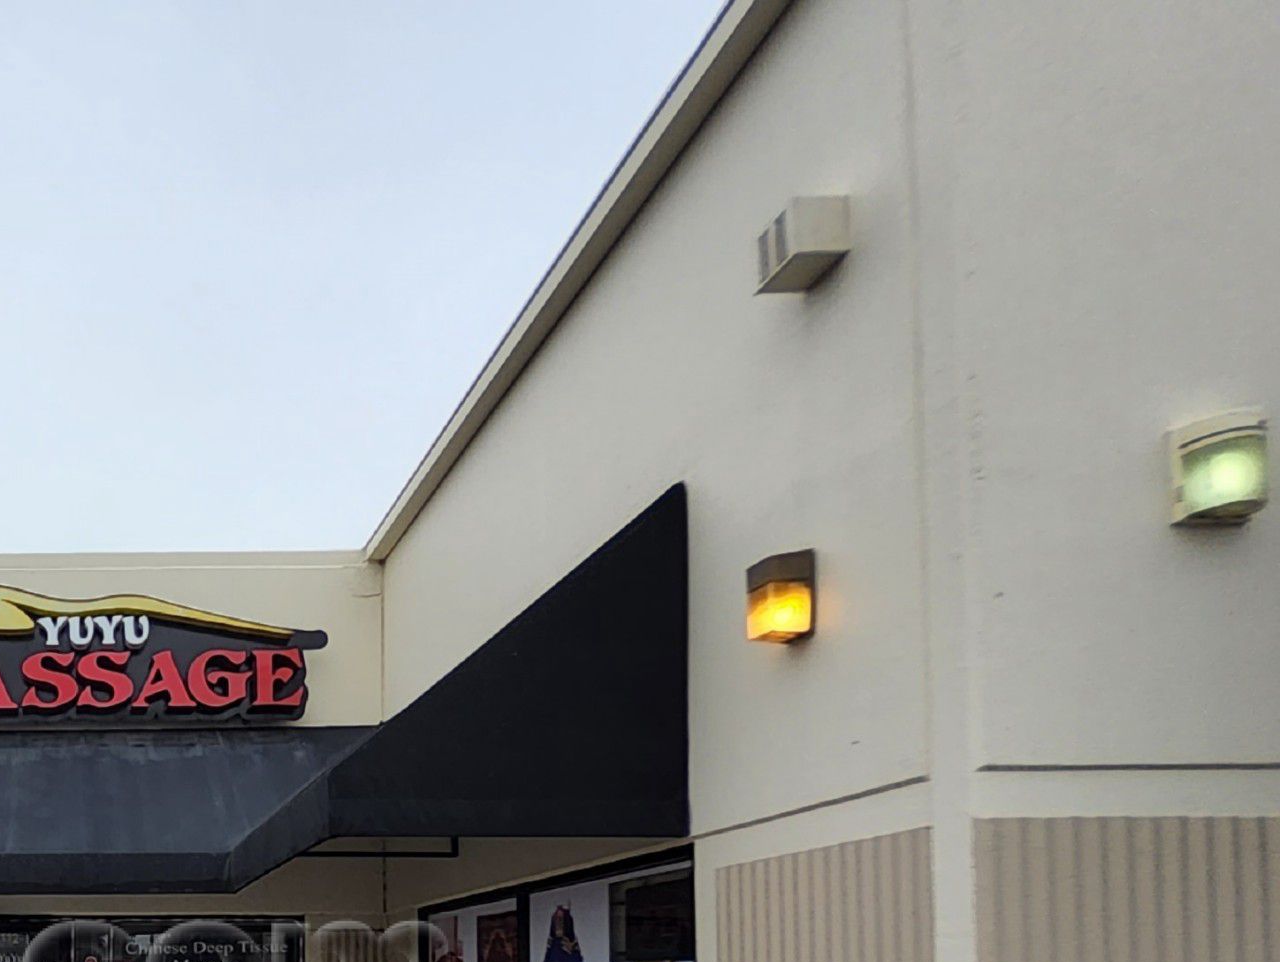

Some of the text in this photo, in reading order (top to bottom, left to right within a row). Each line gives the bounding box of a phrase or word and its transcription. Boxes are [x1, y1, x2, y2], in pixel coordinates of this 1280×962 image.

[35, 614, 150, 647] YUYU
[125, 940, 289, 957] Chinese Deep Tissue
